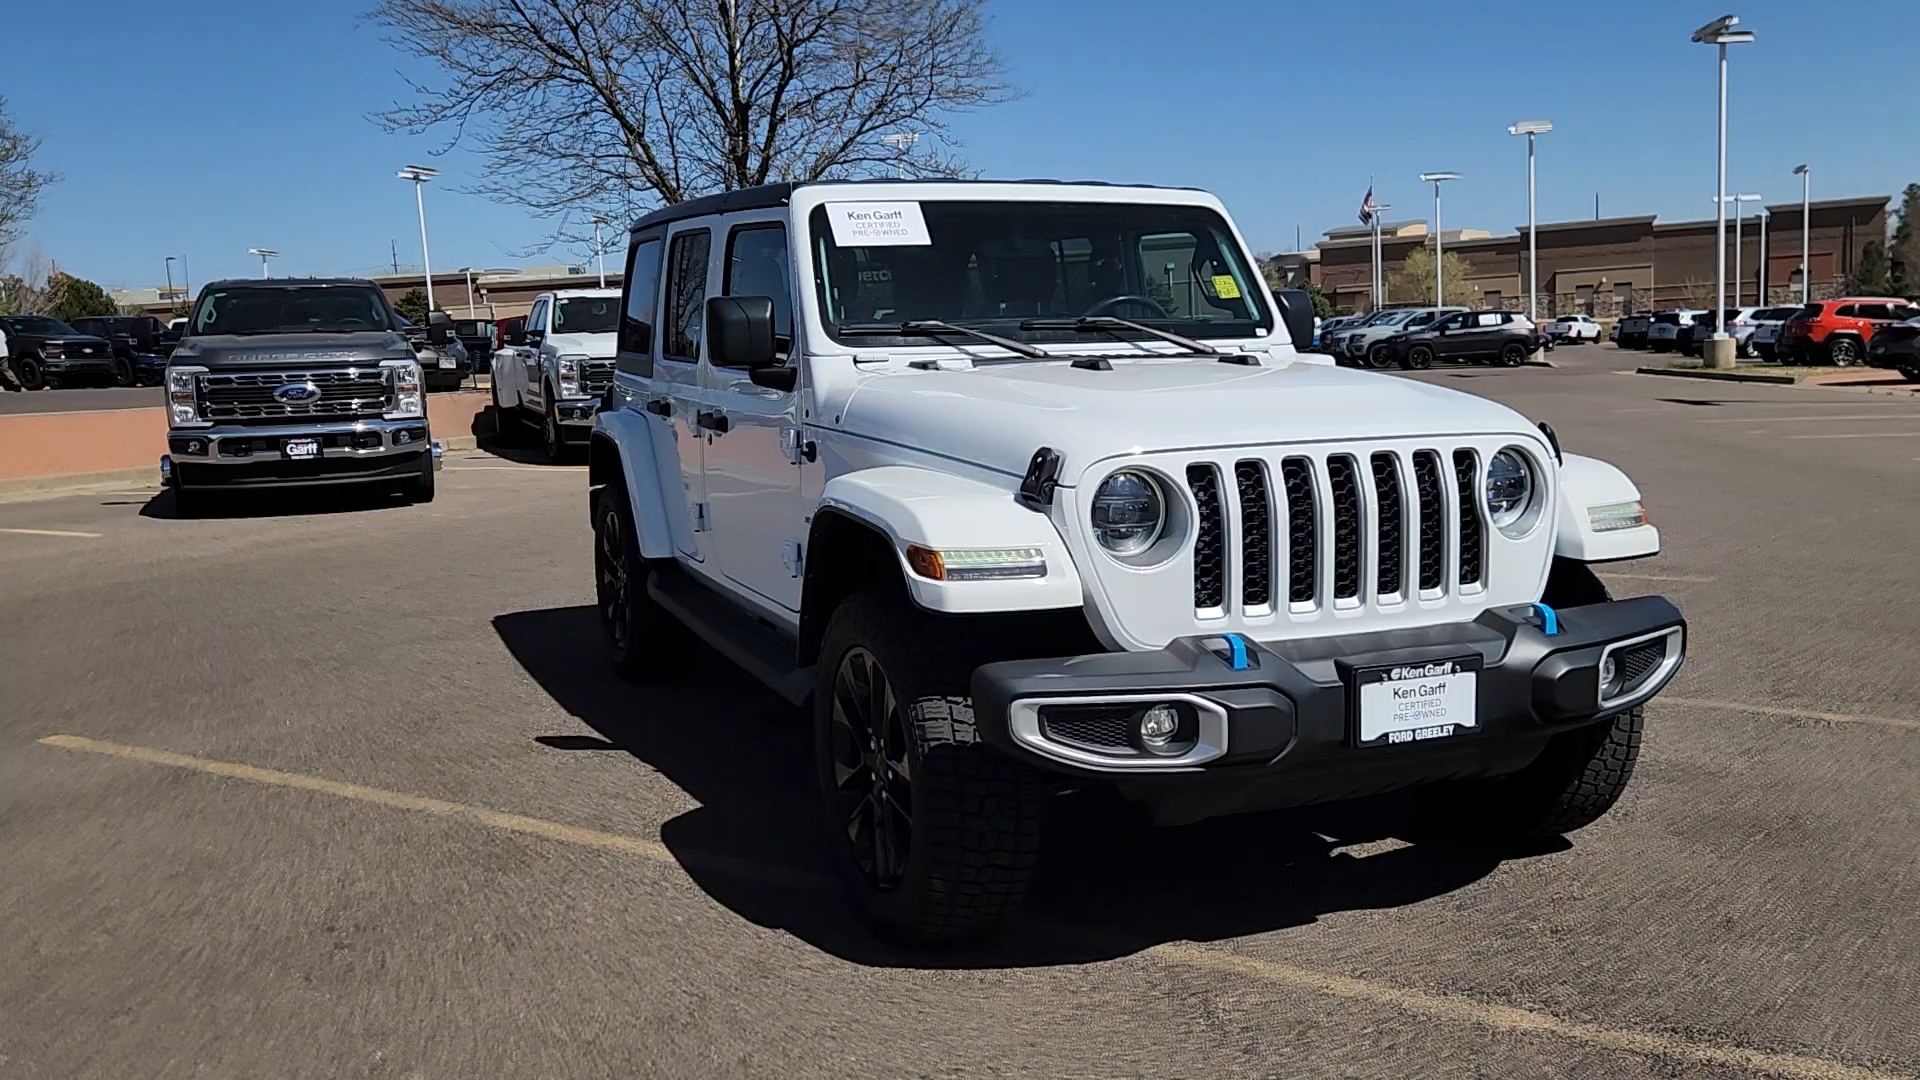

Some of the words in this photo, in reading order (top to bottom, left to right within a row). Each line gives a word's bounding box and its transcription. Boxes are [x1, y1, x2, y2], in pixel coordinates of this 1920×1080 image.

[846, 210, 872, 221] Ken
[872, 210, 903, 221] Garff
[855, 221, 901, 229] CERTIFIED
[286, 442, 318, 456] Garff
[1401, 666, 1424, 680] Ken
[1424, 662, 1453, 677] Garff
[1392, 686, 1417, 701] Ken
[1418, 682, 1446, 697] Garff
[1398, 698, 1442, 712] CERTIFIED
[1393, 708, 1447, 722] PRE-OWNED
[1388, 731, 1413, 744] FORD
[1415, 725, 1454, 740] GREELEY
